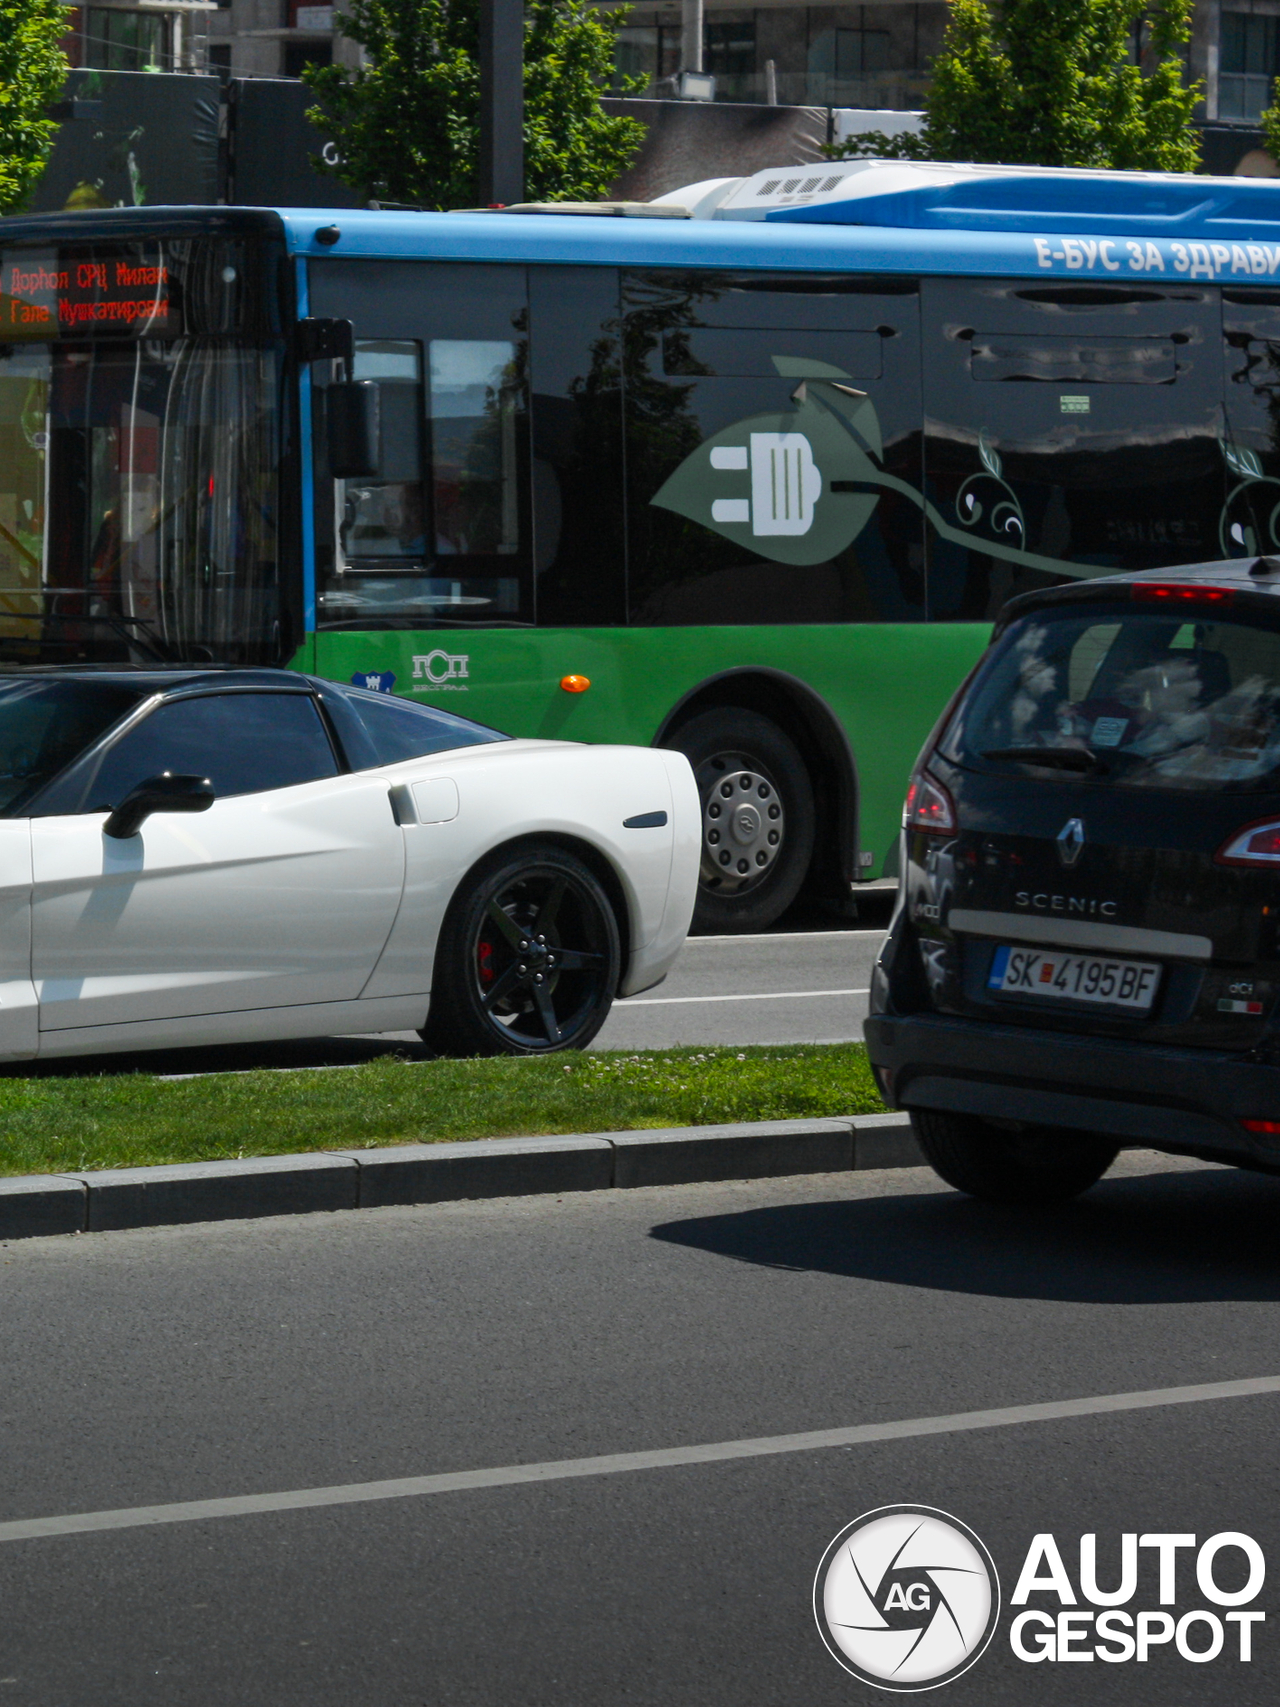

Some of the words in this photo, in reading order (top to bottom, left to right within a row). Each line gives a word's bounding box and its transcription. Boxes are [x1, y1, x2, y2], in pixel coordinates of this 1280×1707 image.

[1033, 238, 1120, 271] Е-БУС
[1126, 241, 1165, 272] ЗА
[1016, 891, 1117, 916] SCENIC
[1007, 953, 1041, 988] SK
